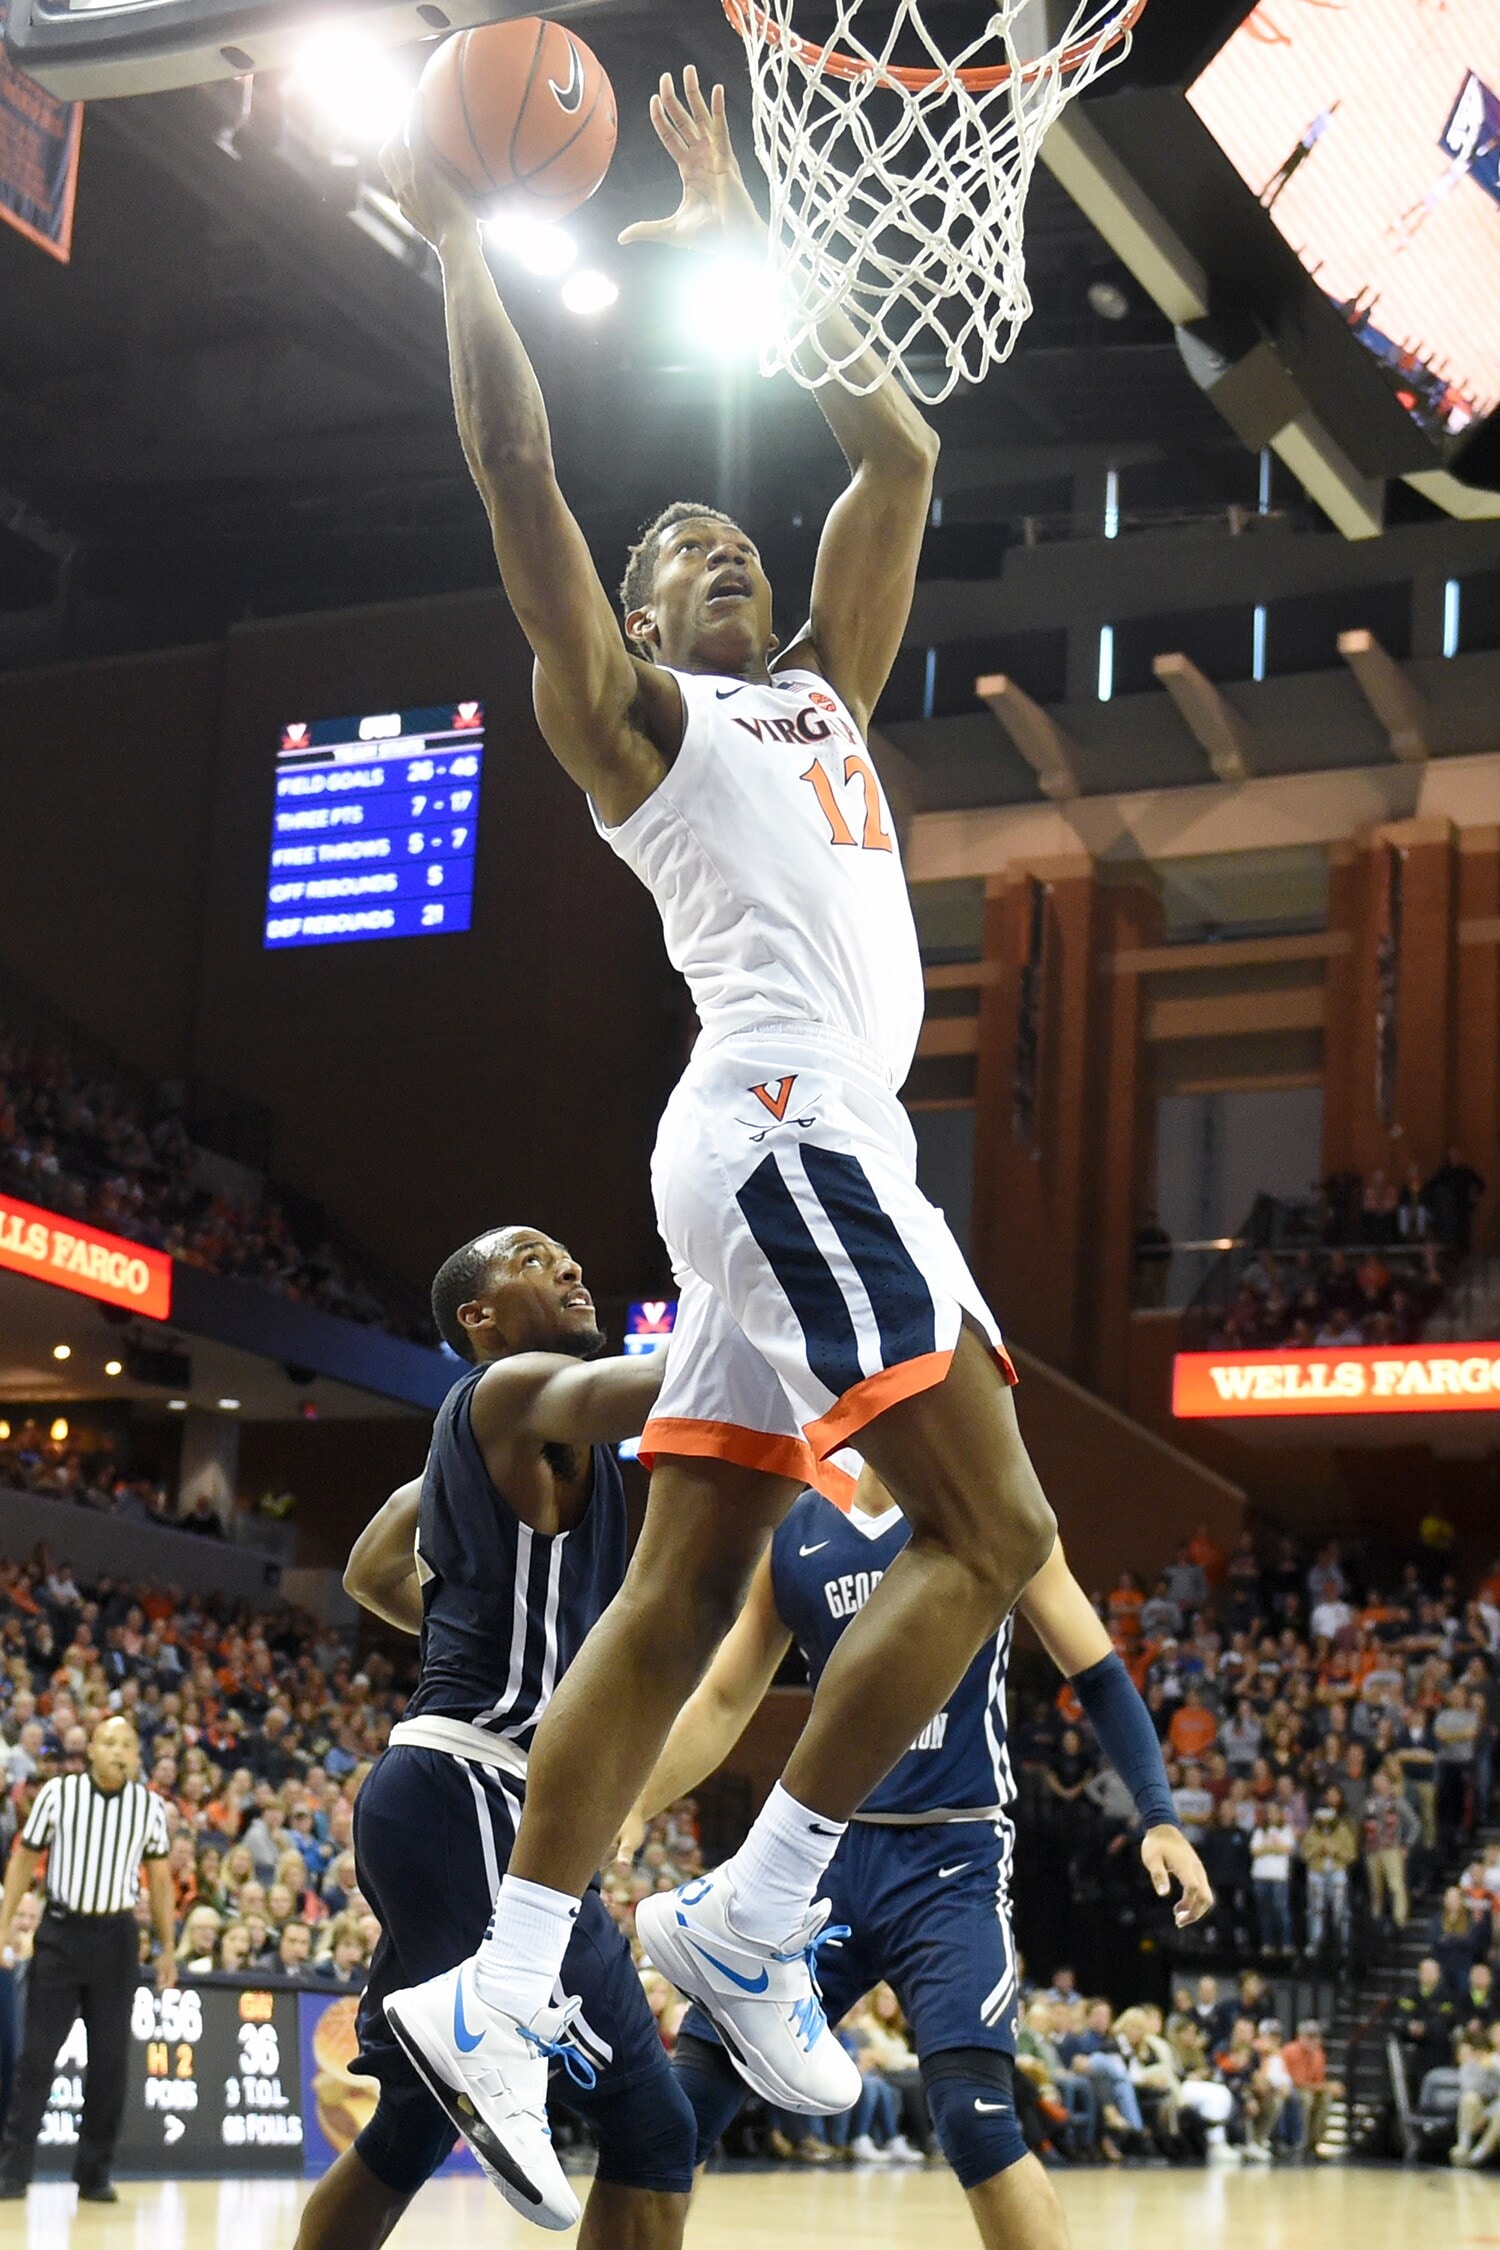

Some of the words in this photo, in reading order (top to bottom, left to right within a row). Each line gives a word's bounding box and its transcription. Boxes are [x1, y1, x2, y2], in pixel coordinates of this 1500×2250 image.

[800, 756, 893, 854] 12
[50, 1231, 150, 1295] FARGO
[1209, 1361, 1367, 1400] WELLS
[147, 2042, 169, 2076] H
[176, 2043, 193, 2077] 2
[238, 2022, 280, 2075] 36
